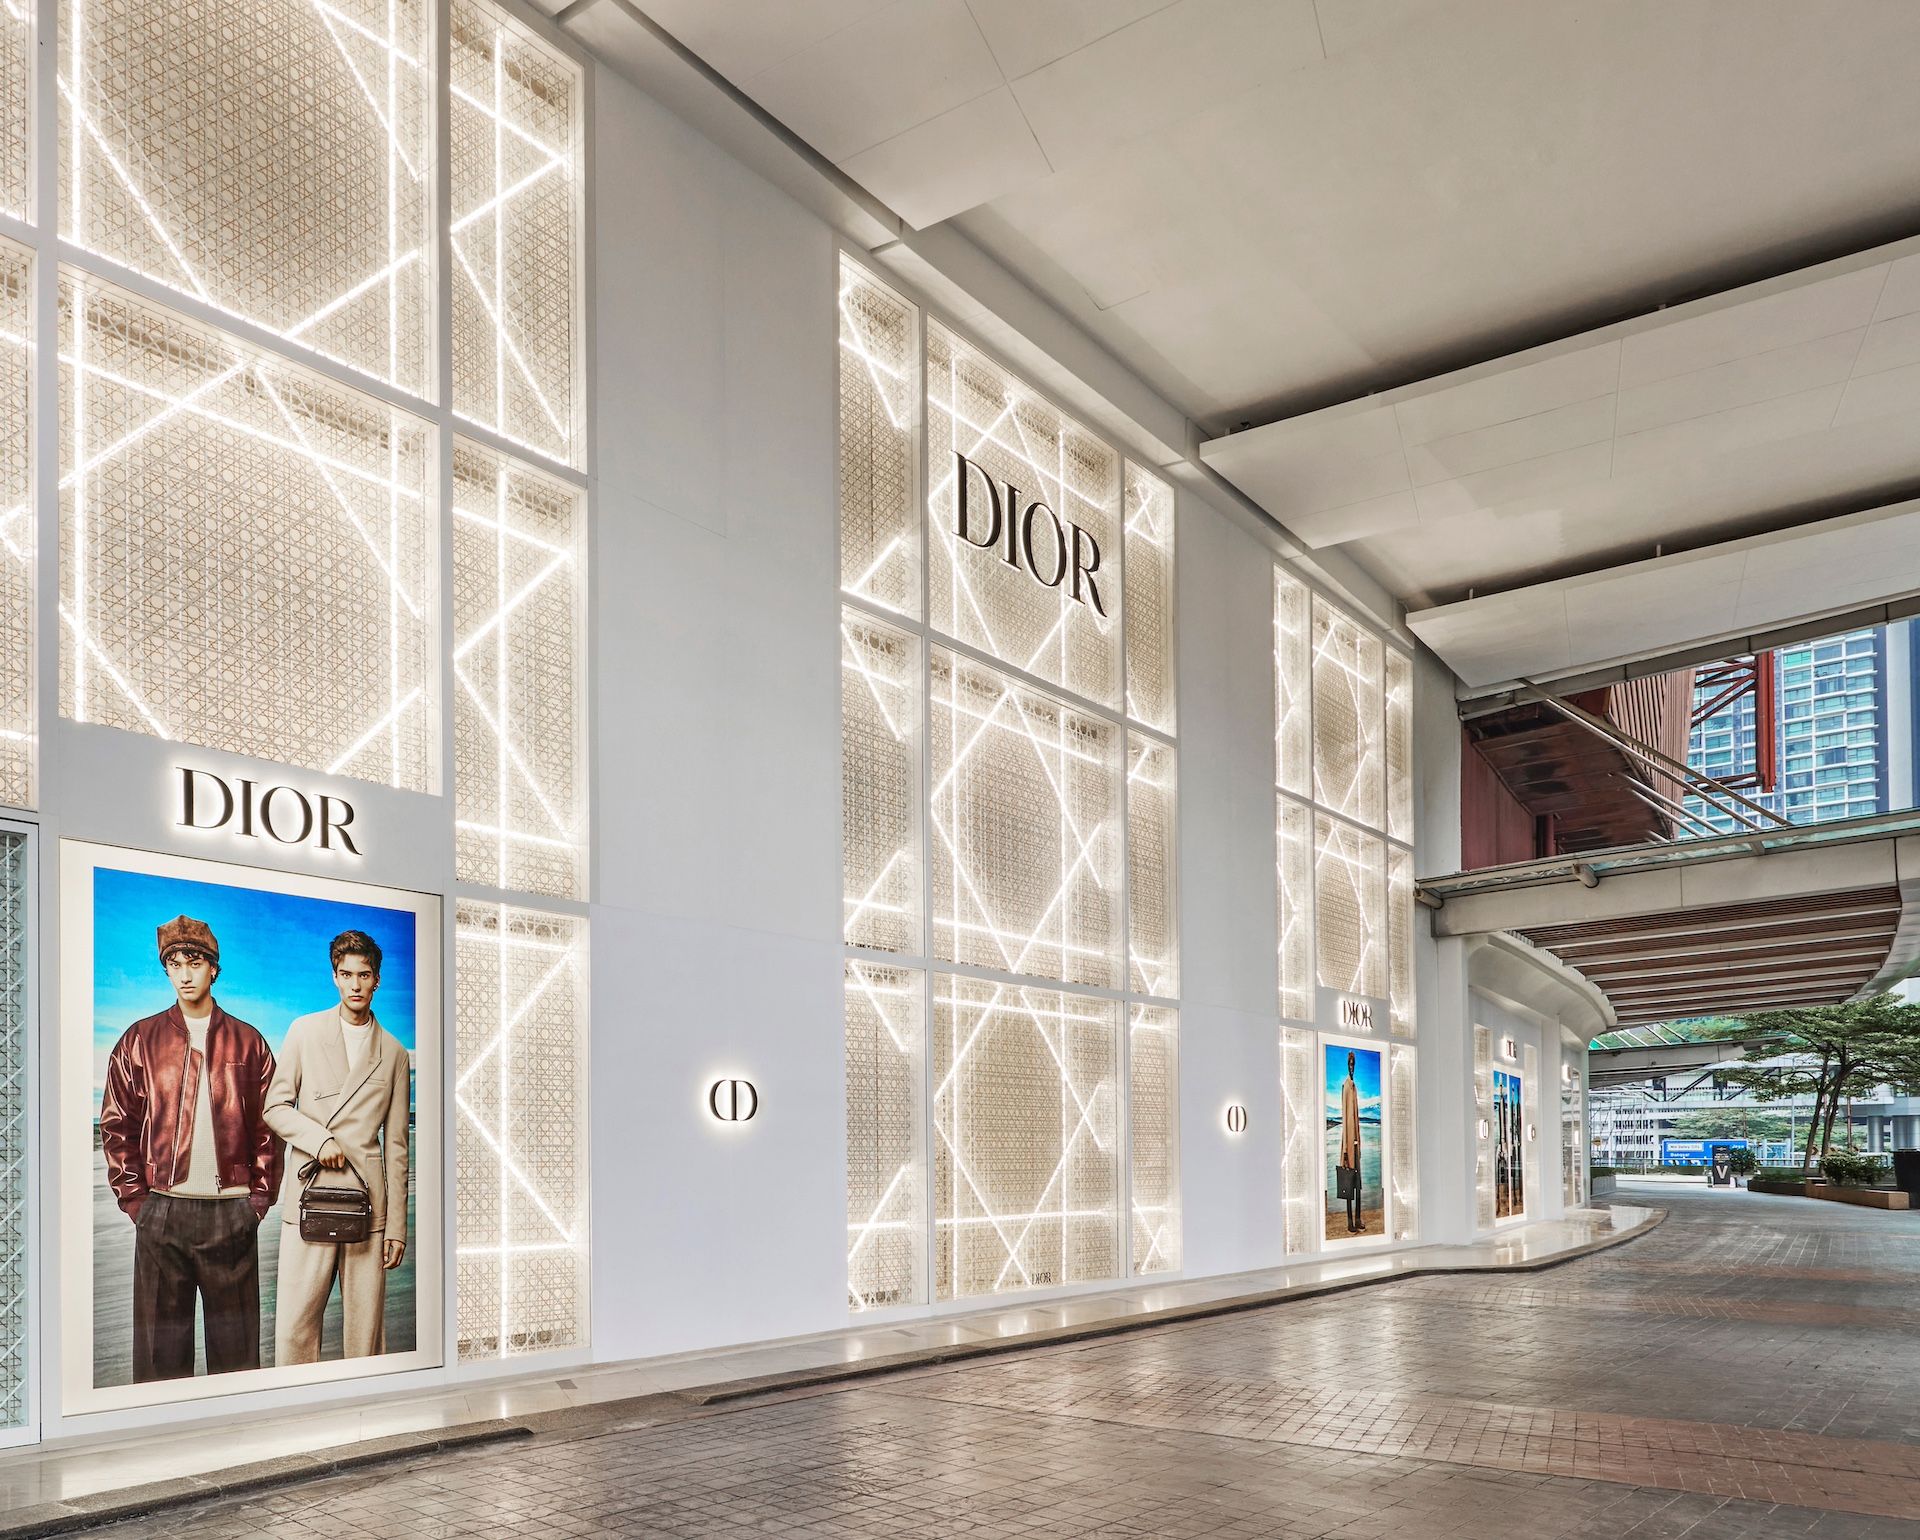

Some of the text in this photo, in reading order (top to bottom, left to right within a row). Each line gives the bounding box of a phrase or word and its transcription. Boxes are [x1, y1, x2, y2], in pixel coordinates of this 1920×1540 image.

[950, 449, 1108, 618] DIOR
[175, 766, 364, 856] DIOR
[1343, 1000, 1374, 1029] DIOR
[1716, 1165, 1728, 1179] V
